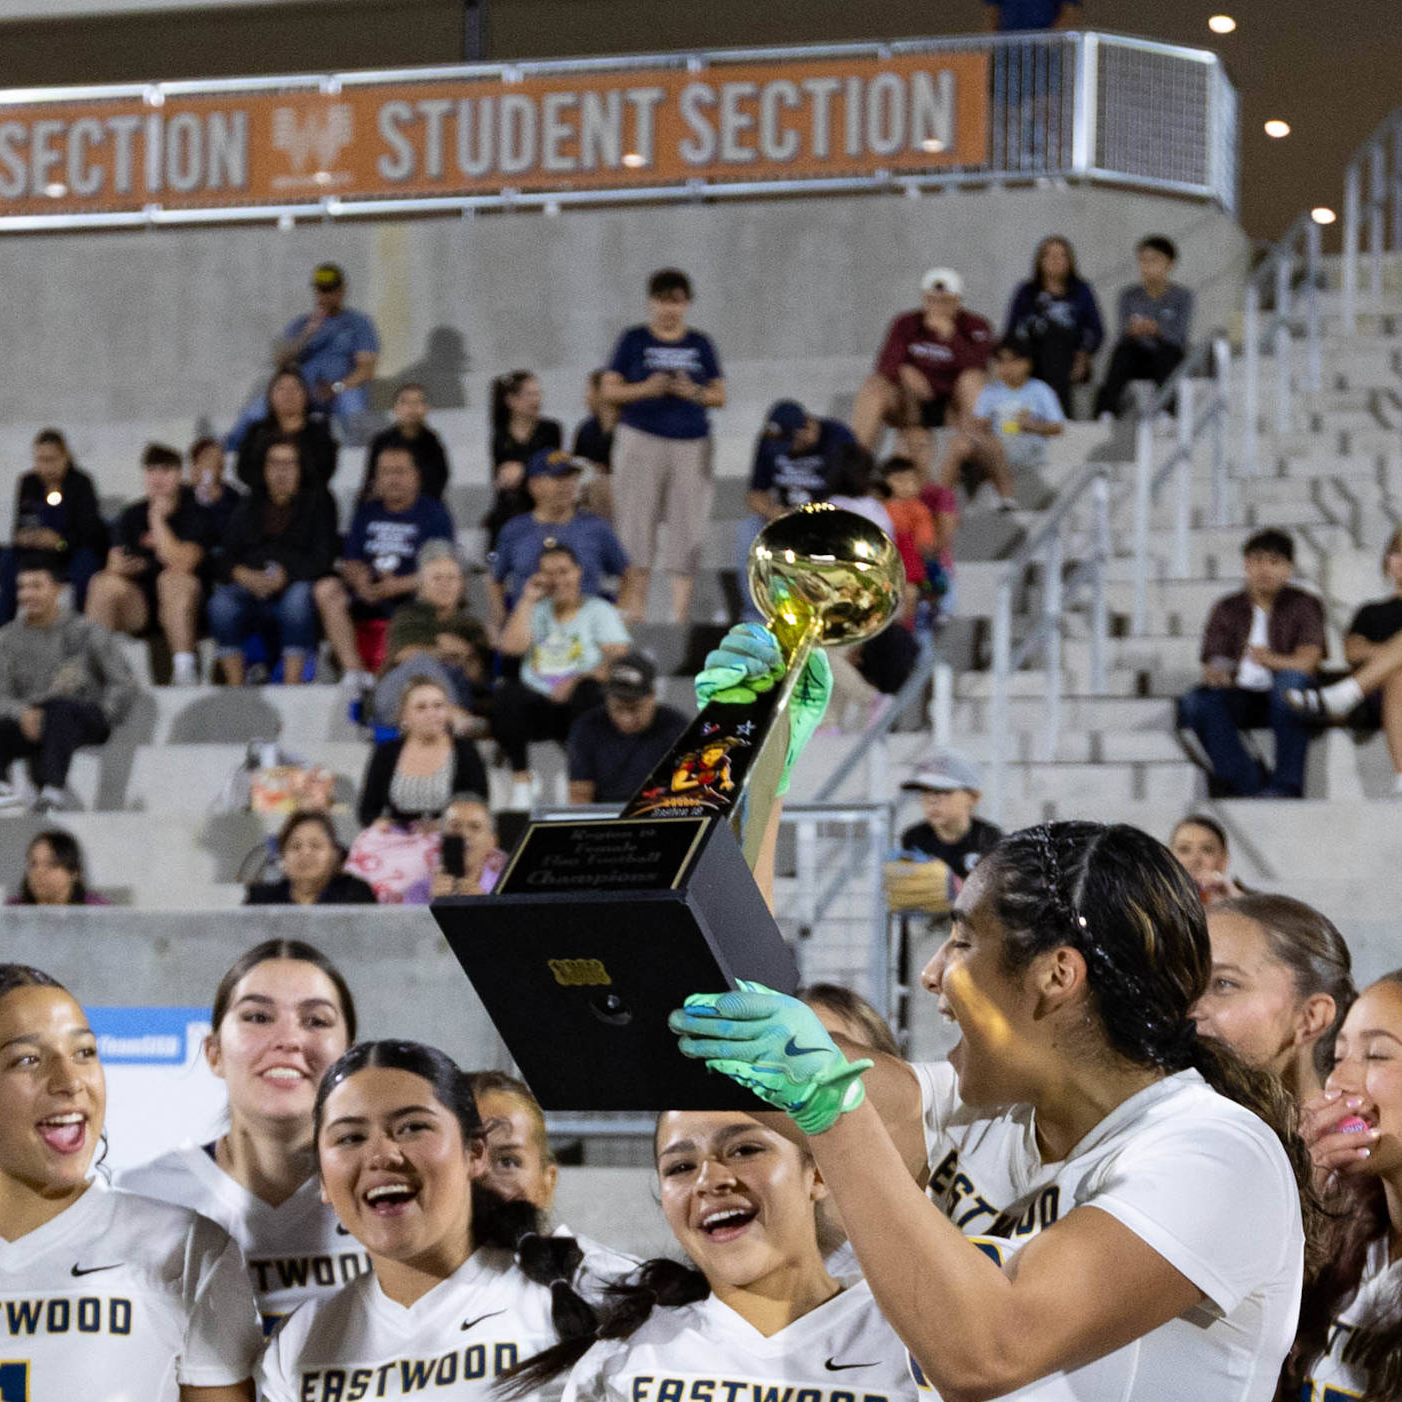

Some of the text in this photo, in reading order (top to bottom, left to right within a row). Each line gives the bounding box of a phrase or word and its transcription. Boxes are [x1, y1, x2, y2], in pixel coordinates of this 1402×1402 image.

[376, 69, 957, 181] STUDENT SECTION
[526, 869, 659, 886] Champions
